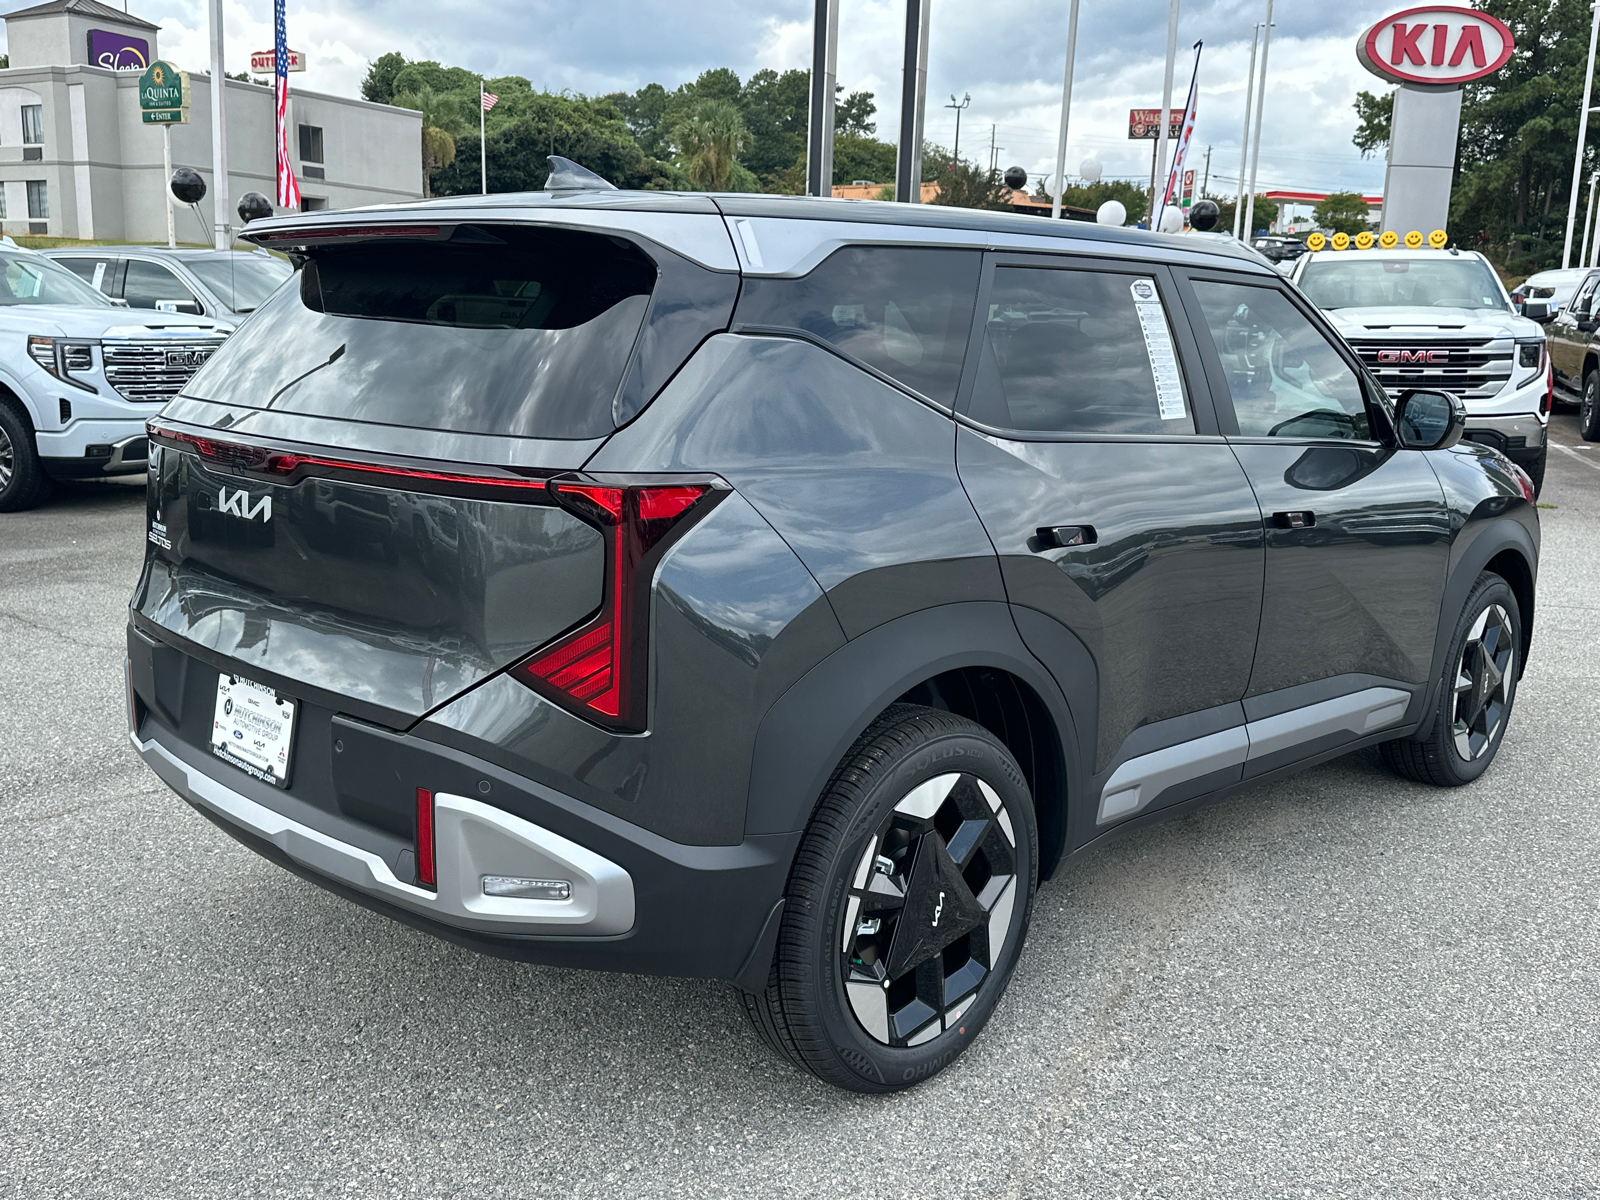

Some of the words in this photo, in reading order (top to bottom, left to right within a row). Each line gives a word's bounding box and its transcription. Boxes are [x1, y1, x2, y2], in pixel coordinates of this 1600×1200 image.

[1390, 23, 1488, 67] KIA
[147, 87, 179, 101] QUINTA
[1133, 110, 1184, 124] Wagrs
[1378, 350, 1450, 363] GMC
[218, 486, 272, 524] KIA
[148, 531, 172, 550] SELTOS
[262, 730, 278, 742] GROUP
[906, 746, 964, 778] SOLUS
[826, 878, 844, 962] ALL-SEASON
